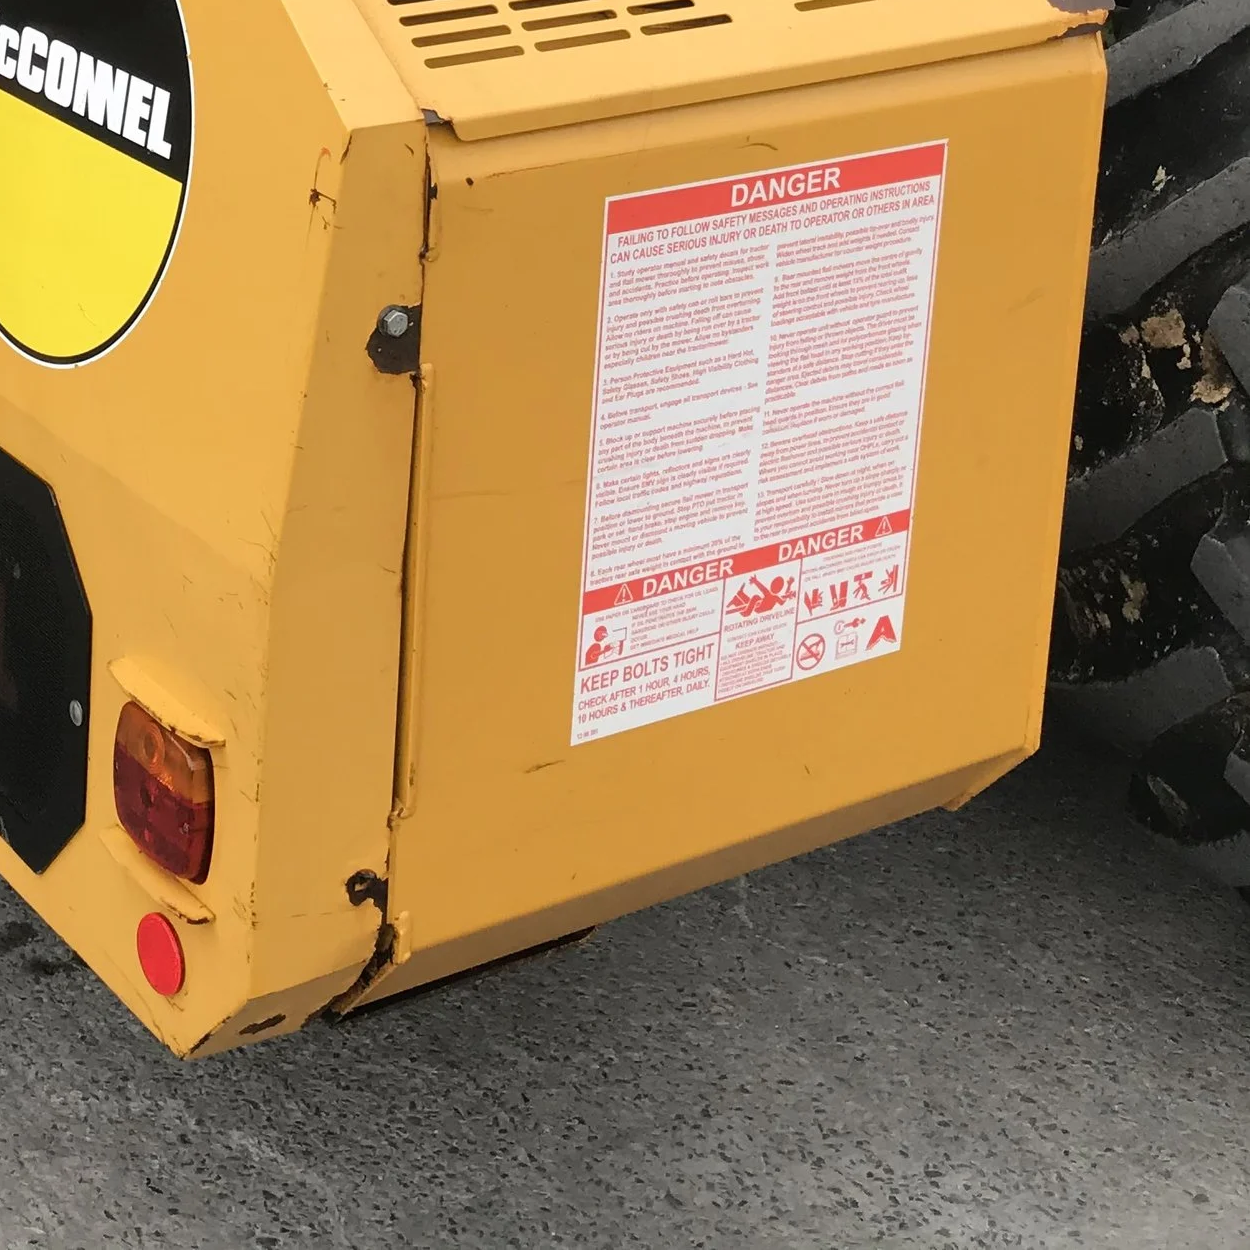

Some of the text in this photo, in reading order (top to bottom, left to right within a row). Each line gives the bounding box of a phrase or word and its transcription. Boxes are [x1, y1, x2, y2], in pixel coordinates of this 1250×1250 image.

[730, 165, 842, 208] DANGER
[610, 193, 934, 265] CAN CAUSE SERIOUS INJURY OR DEATH TO OPERATOR OR OTHERS IN AREA
[617, 179, 930, 249] FAILING TO FOLLOW SAFETY MESSAGES AND OPERATING INSTRUCTIONS
[687, 256, 698, 264] and
[608, 289, 620, 297] and
[609, 280, 621, 288] and
[778, 523, 863, 562] DANGER
[642, 557, 734, 598] DANGER
[724, 616, 758, 633] ROTATING
[735, 637, 754, 649] KEEP
[755, 632, 774, 644] AWAY
[580, 668, 619, 695] KEEP
[623, 654, 669, 683] BOLTS
[672, 641, 714, 669] TIGHT
[578, 694, 607, 711] CHECK
[609, 685, 636, 702] AFTER
[639, 683, 642, 693] 1
[673, 674, 677, 684] 4
[577, 713, 586, 724] 10
[589, 704, 618, 721] HOURS
[620, 701, 626, 712] &
